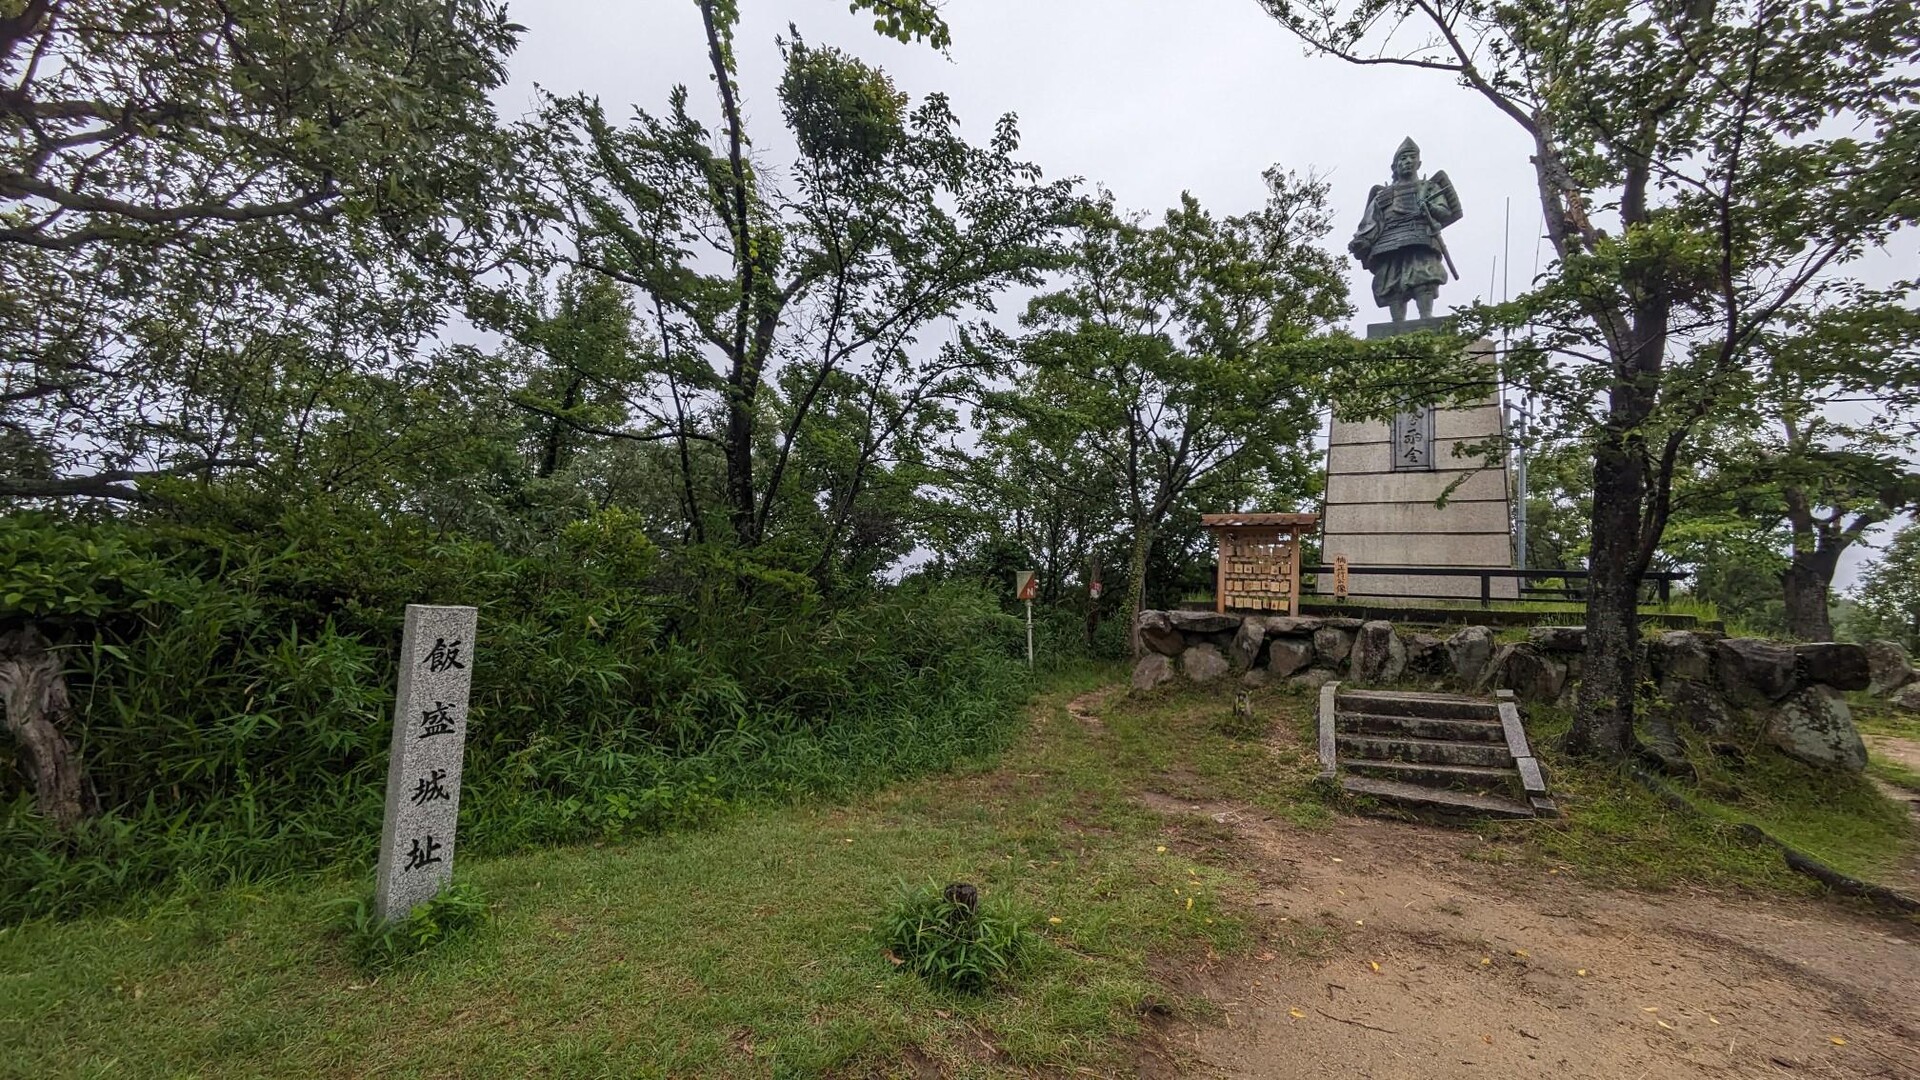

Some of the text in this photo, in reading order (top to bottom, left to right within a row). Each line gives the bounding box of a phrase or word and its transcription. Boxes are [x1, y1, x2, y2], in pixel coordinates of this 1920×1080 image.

[1026, 587, 1034, 596] N
[403, 637, 466, 873] 飯盛城址
